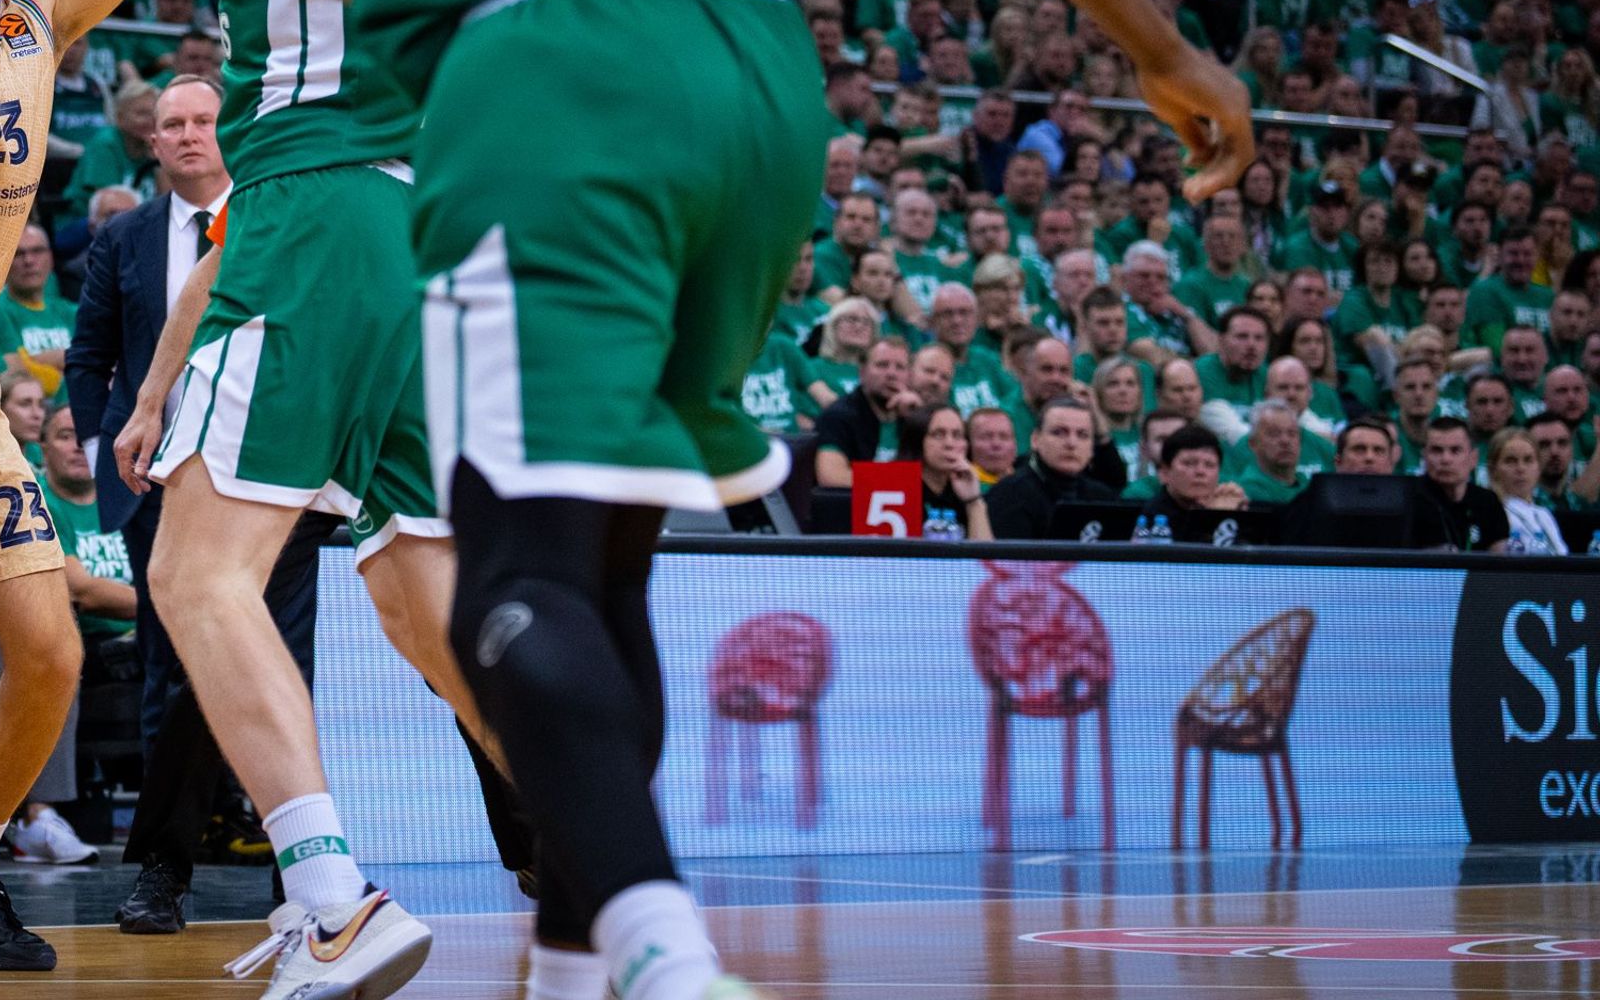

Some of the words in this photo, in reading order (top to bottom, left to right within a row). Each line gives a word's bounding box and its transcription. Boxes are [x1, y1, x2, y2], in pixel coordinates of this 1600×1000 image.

[865, 490, 908, 538] 5
[1502, 599, 1600, 743] Si
[293, 837, 342, 861] GSA
